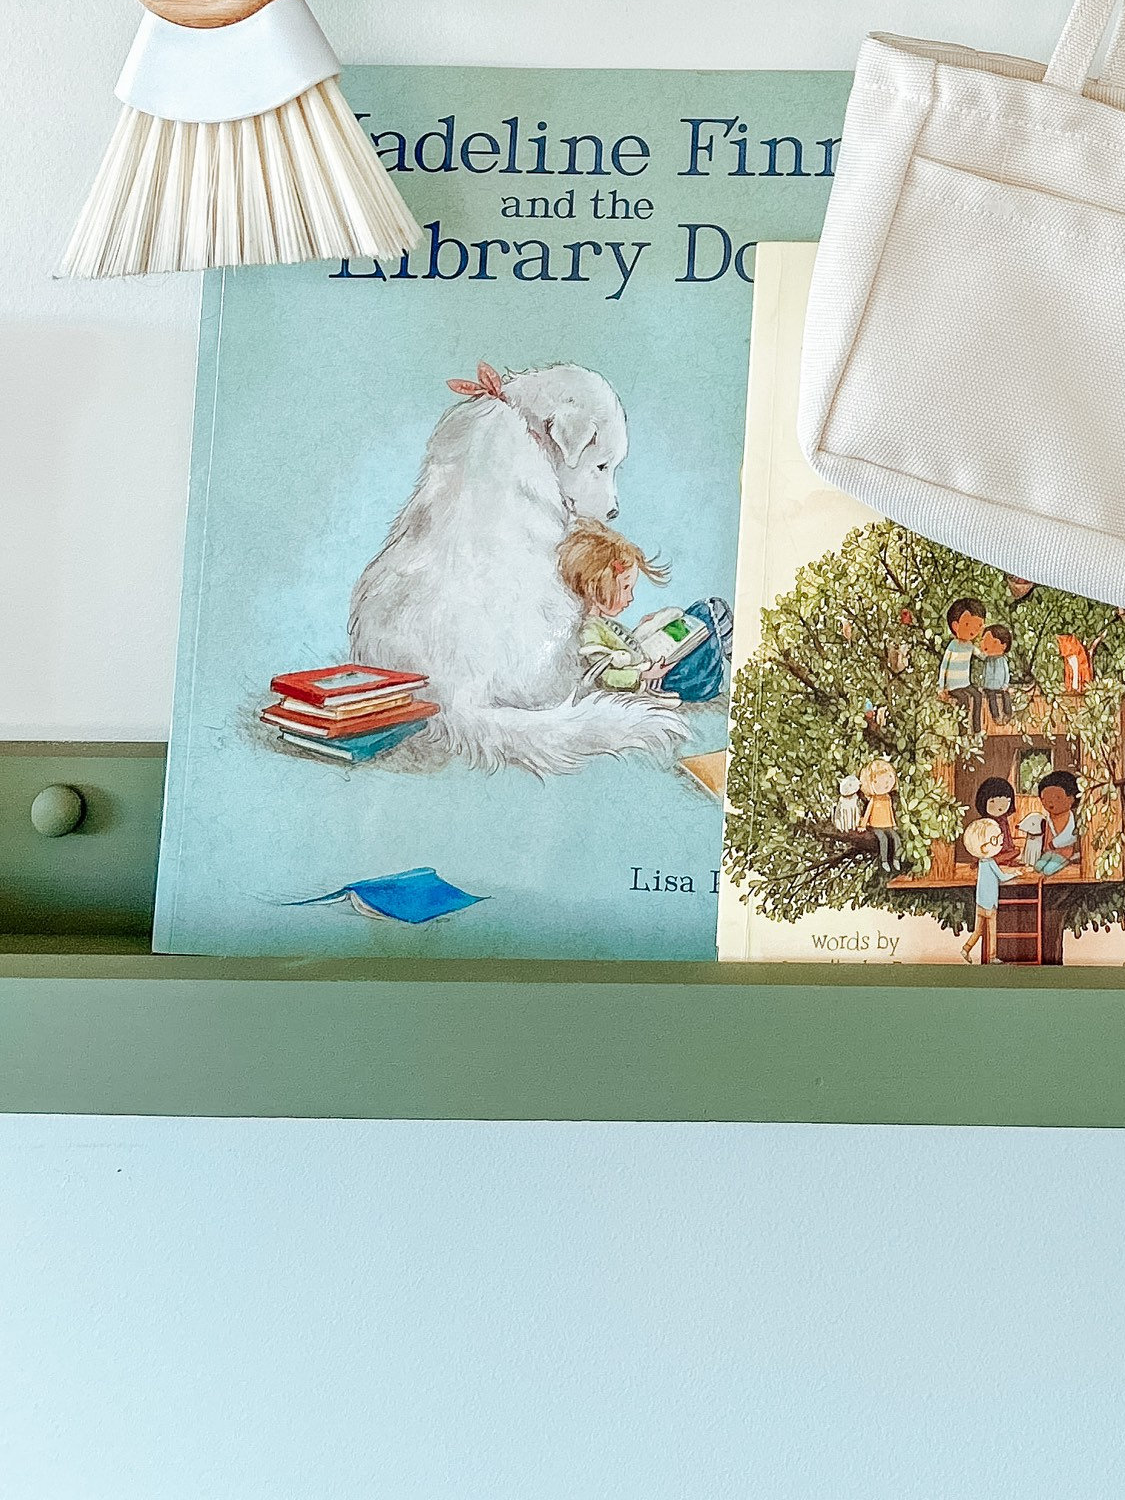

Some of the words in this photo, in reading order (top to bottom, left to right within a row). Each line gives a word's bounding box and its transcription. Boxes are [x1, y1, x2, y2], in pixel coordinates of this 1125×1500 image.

[354, 114, 651, 177] adeline
[501, 190, 577, 220] and
[590, 190, 655, 220] the
[629, 867, 696, 893] Lisa
[812, 930, 870, 952] words
[877, 930, 900, 955] by
